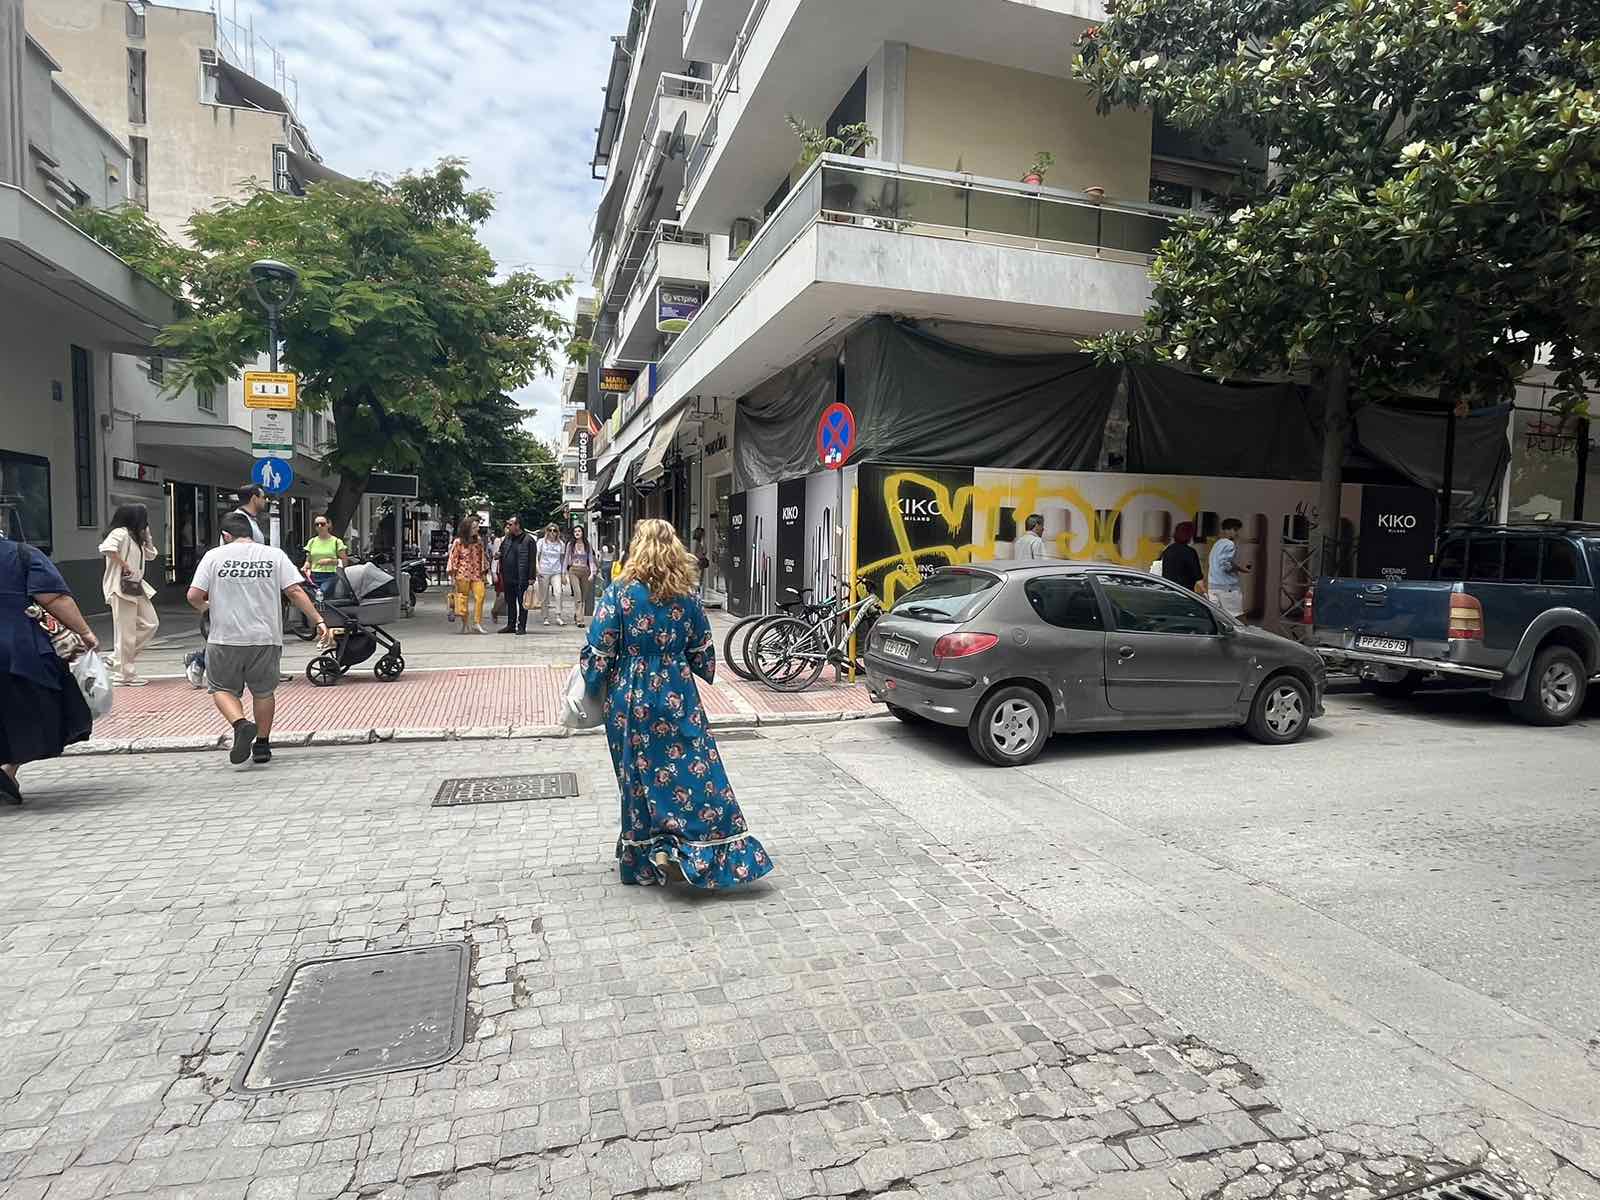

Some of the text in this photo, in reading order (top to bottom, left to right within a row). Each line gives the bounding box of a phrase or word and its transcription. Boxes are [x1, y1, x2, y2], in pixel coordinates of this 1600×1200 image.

[579, 432, 588, 472] COSMOS
[782, 506, 799, 521] KIKO
[1378, 514, 1416, 528] KIKO
[223, 560, 273, 569] SPORTS
